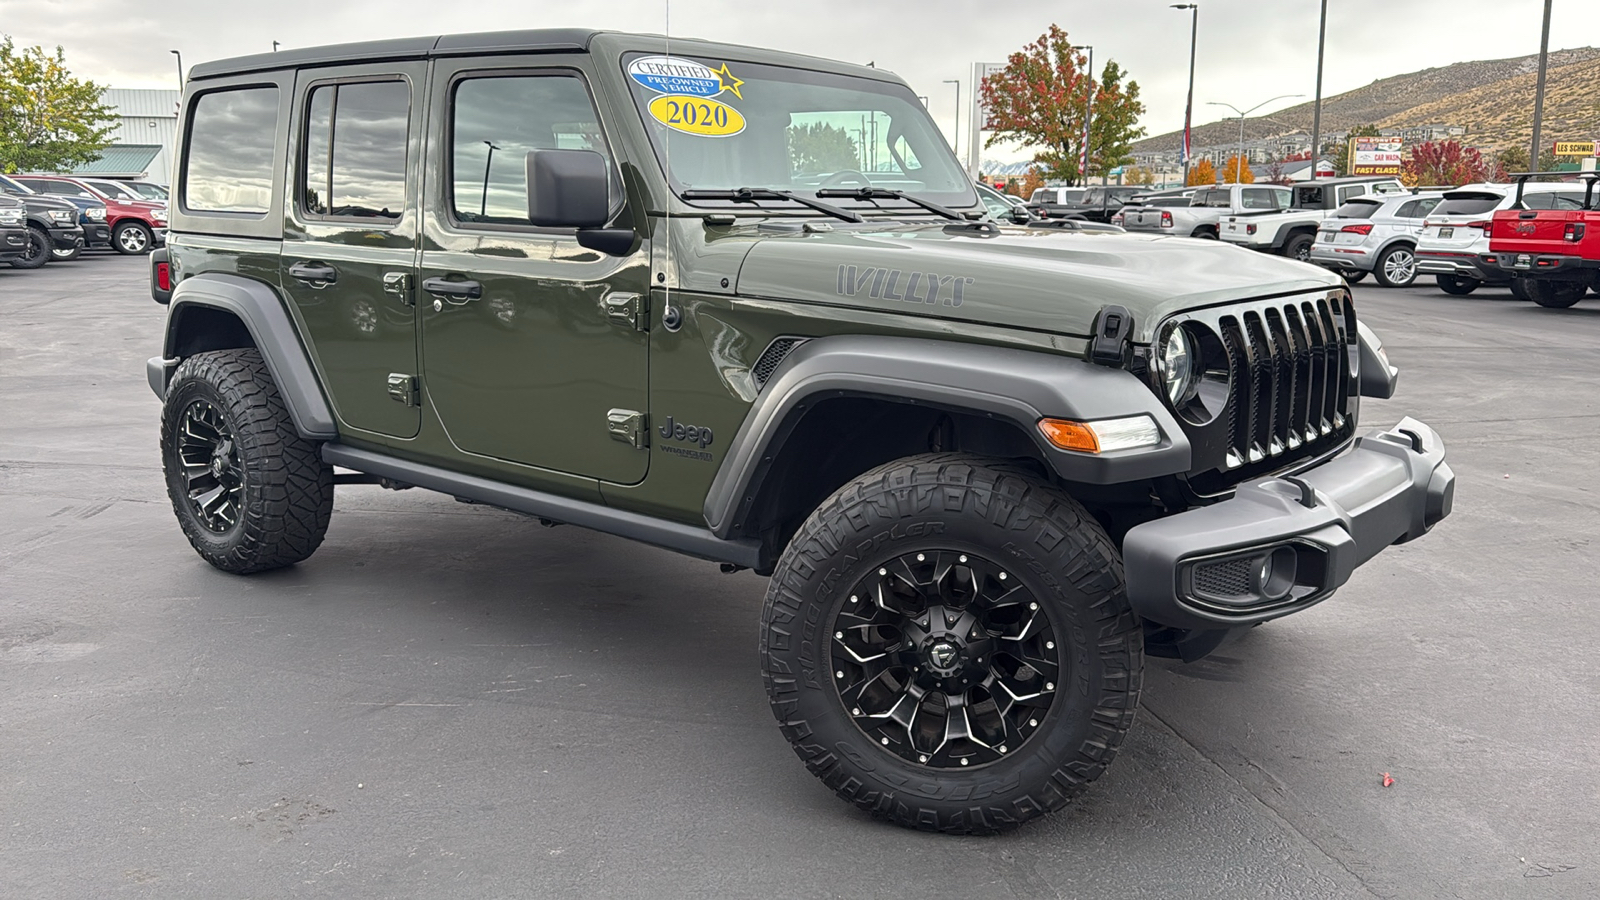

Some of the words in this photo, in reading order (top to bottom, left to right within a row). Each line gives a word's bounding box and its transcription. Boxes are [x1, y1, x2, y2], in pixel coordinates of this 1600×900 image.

[636, 62, 712, 79] CERTIFIED
[647, 76, 714, 88] PRE-OWNED
[661, 84, 710, 94] VEHICLE
[667, 101, 728, 128] 2020
[1557, 144, 1568, 152] LES
[1569, 144, 1594, 152] SCHWAB
[837, 264, 975, 308] WILLYS
[658, 415, 714, 449] Jeep
[660, 445, 714, 460] WRANGLER
[815, 521, 945, 603] GRAPPLER
